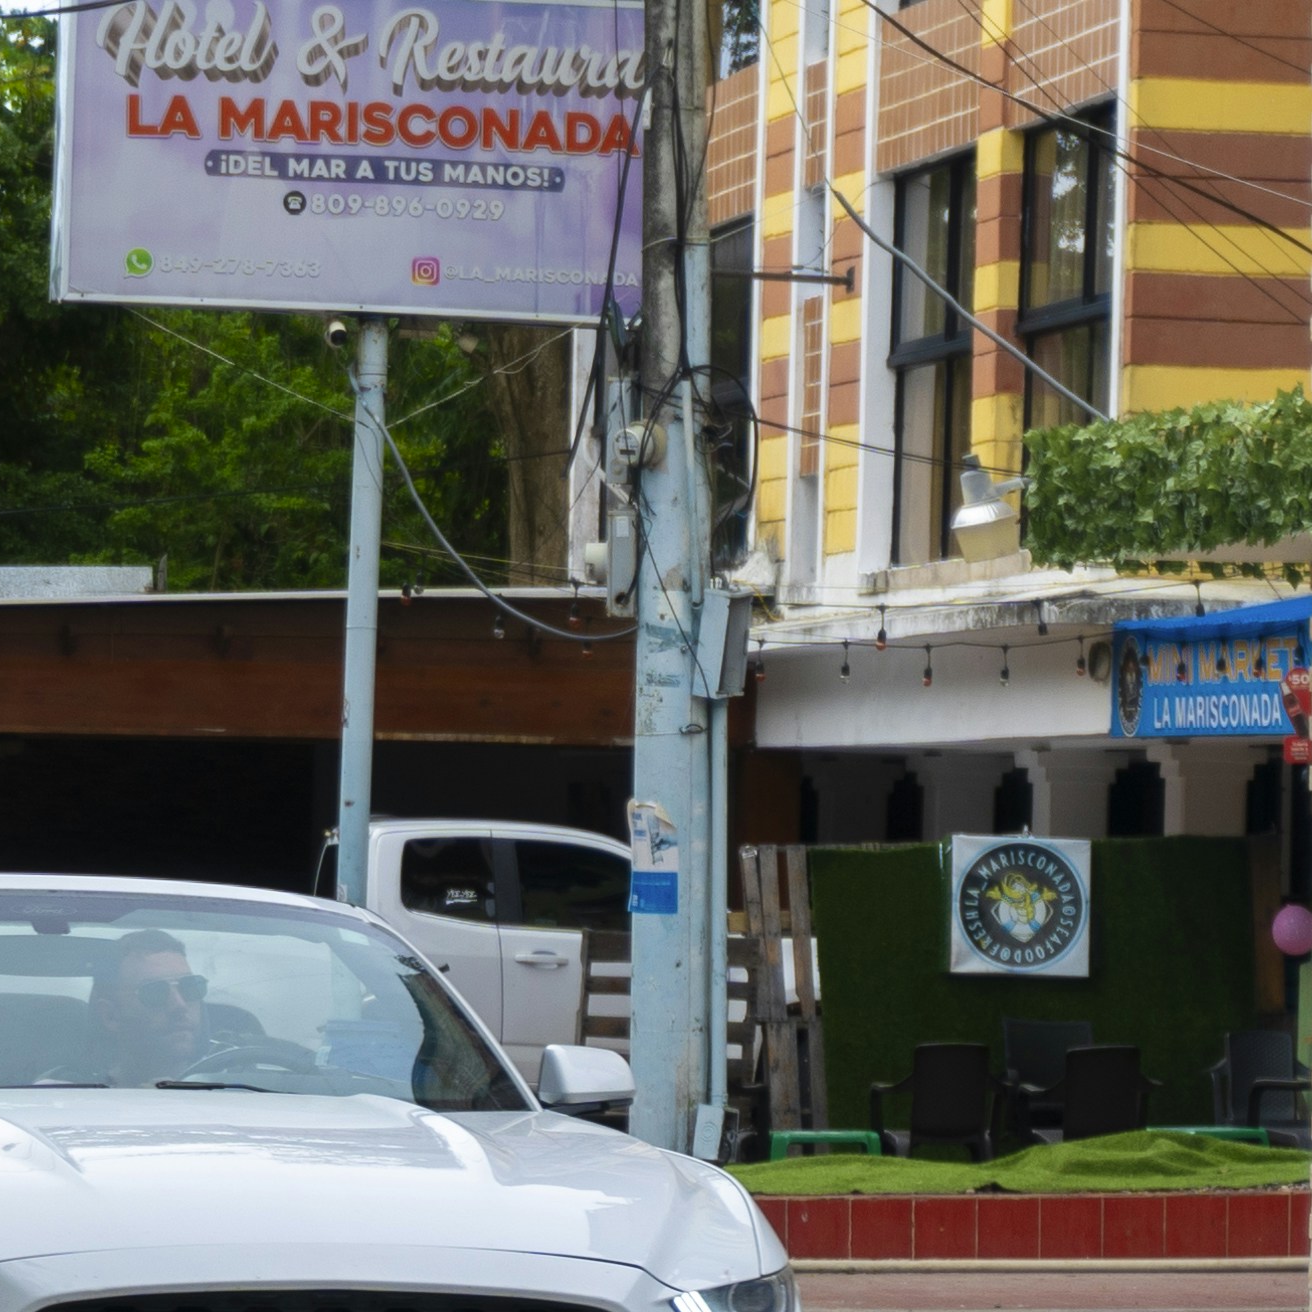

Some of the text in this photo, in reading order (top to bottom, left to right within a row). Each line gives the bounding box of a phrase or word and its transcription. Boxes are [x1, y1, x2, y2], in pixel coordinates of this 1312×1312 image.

[96, 0, 278, 86] Hotel
[297, 5, 368, 93] &
[126, 94, 641, 157] LA MARISCONADA
[219, 154, 550, 188] ¡DEL MAR A TUS MANOS!
[310, 193, 505, 221] 809-896-0929
[444, 265, 639, 287] @LA_MARISCONADA
[1147, 635, 1299, 687] MINI MARKET
[1153, 693, 1283, 729] LA MARISCONADA
